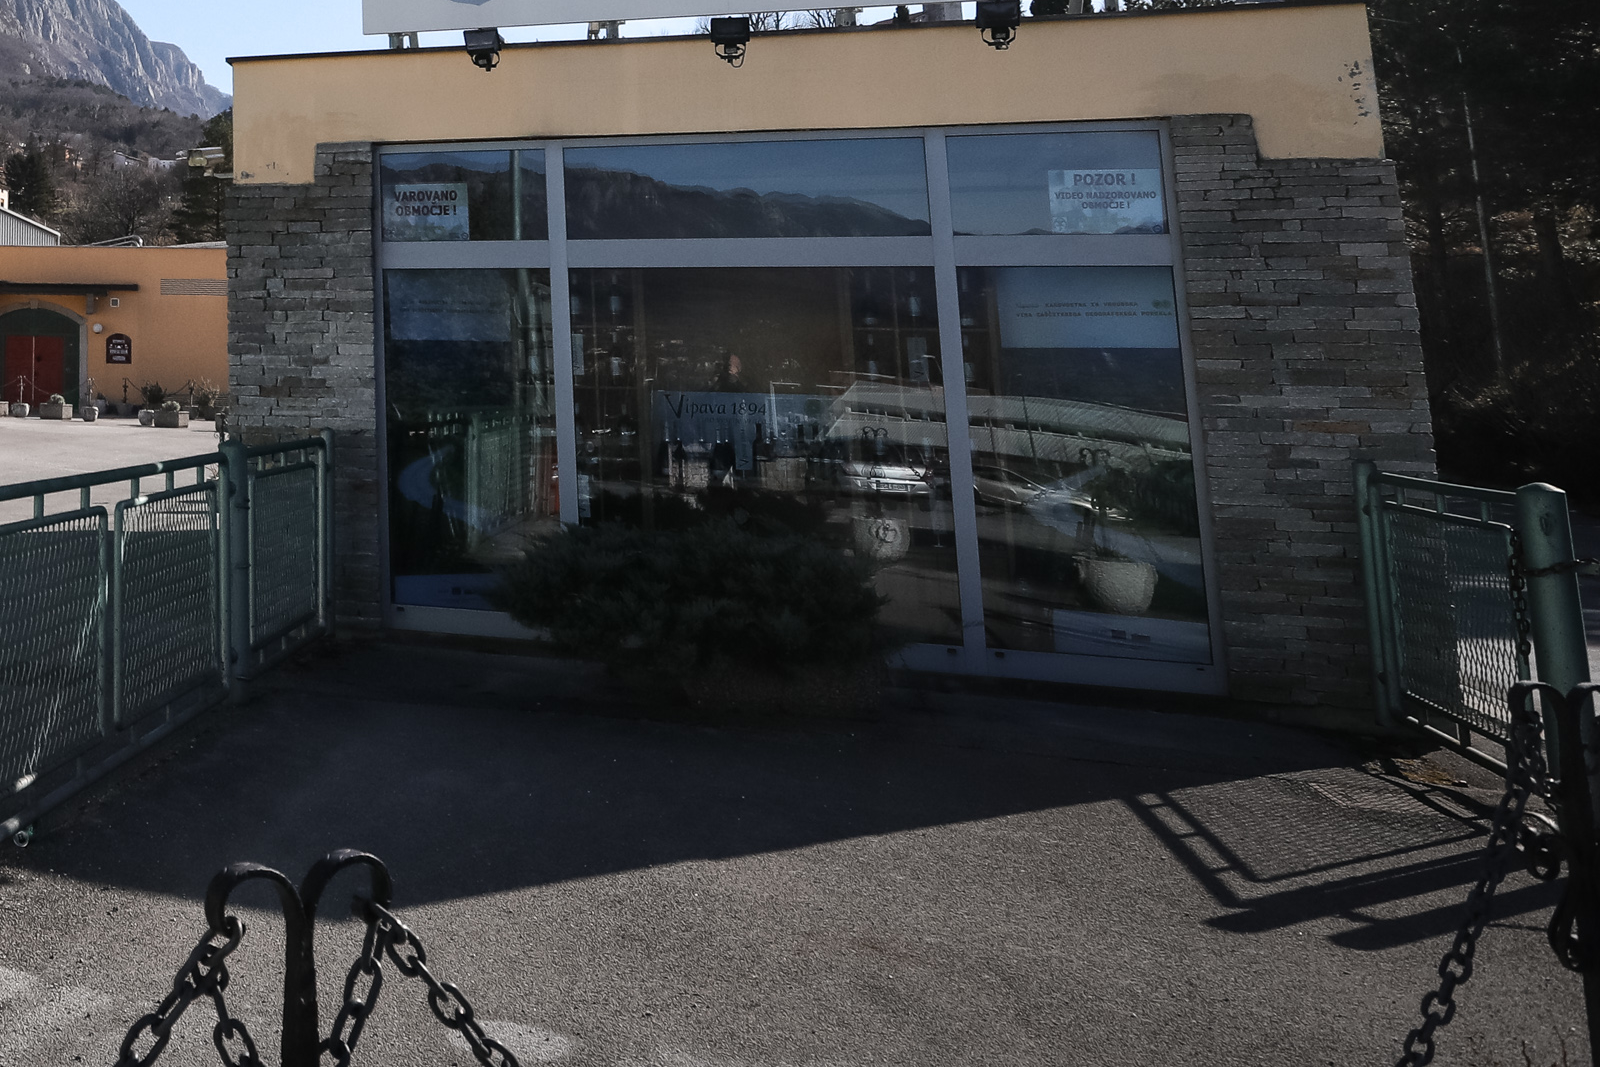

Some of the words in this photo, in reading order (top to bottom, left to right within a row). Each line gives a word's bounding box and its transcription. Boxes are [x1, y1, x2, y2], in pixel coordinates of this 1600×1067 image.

[1074, 173, 1126, 185] POZOR
[394, 190, 458, 202] VAROVANO
[1055, 191, 1084, 200] VIDEO
[1086, 191, 1157, 200] NADZOROVANO
[395, 201, 450, 216] OBMOČJE
[664, 394, 726, 419] Vipava
[730, 401, 767, 416] 1894
